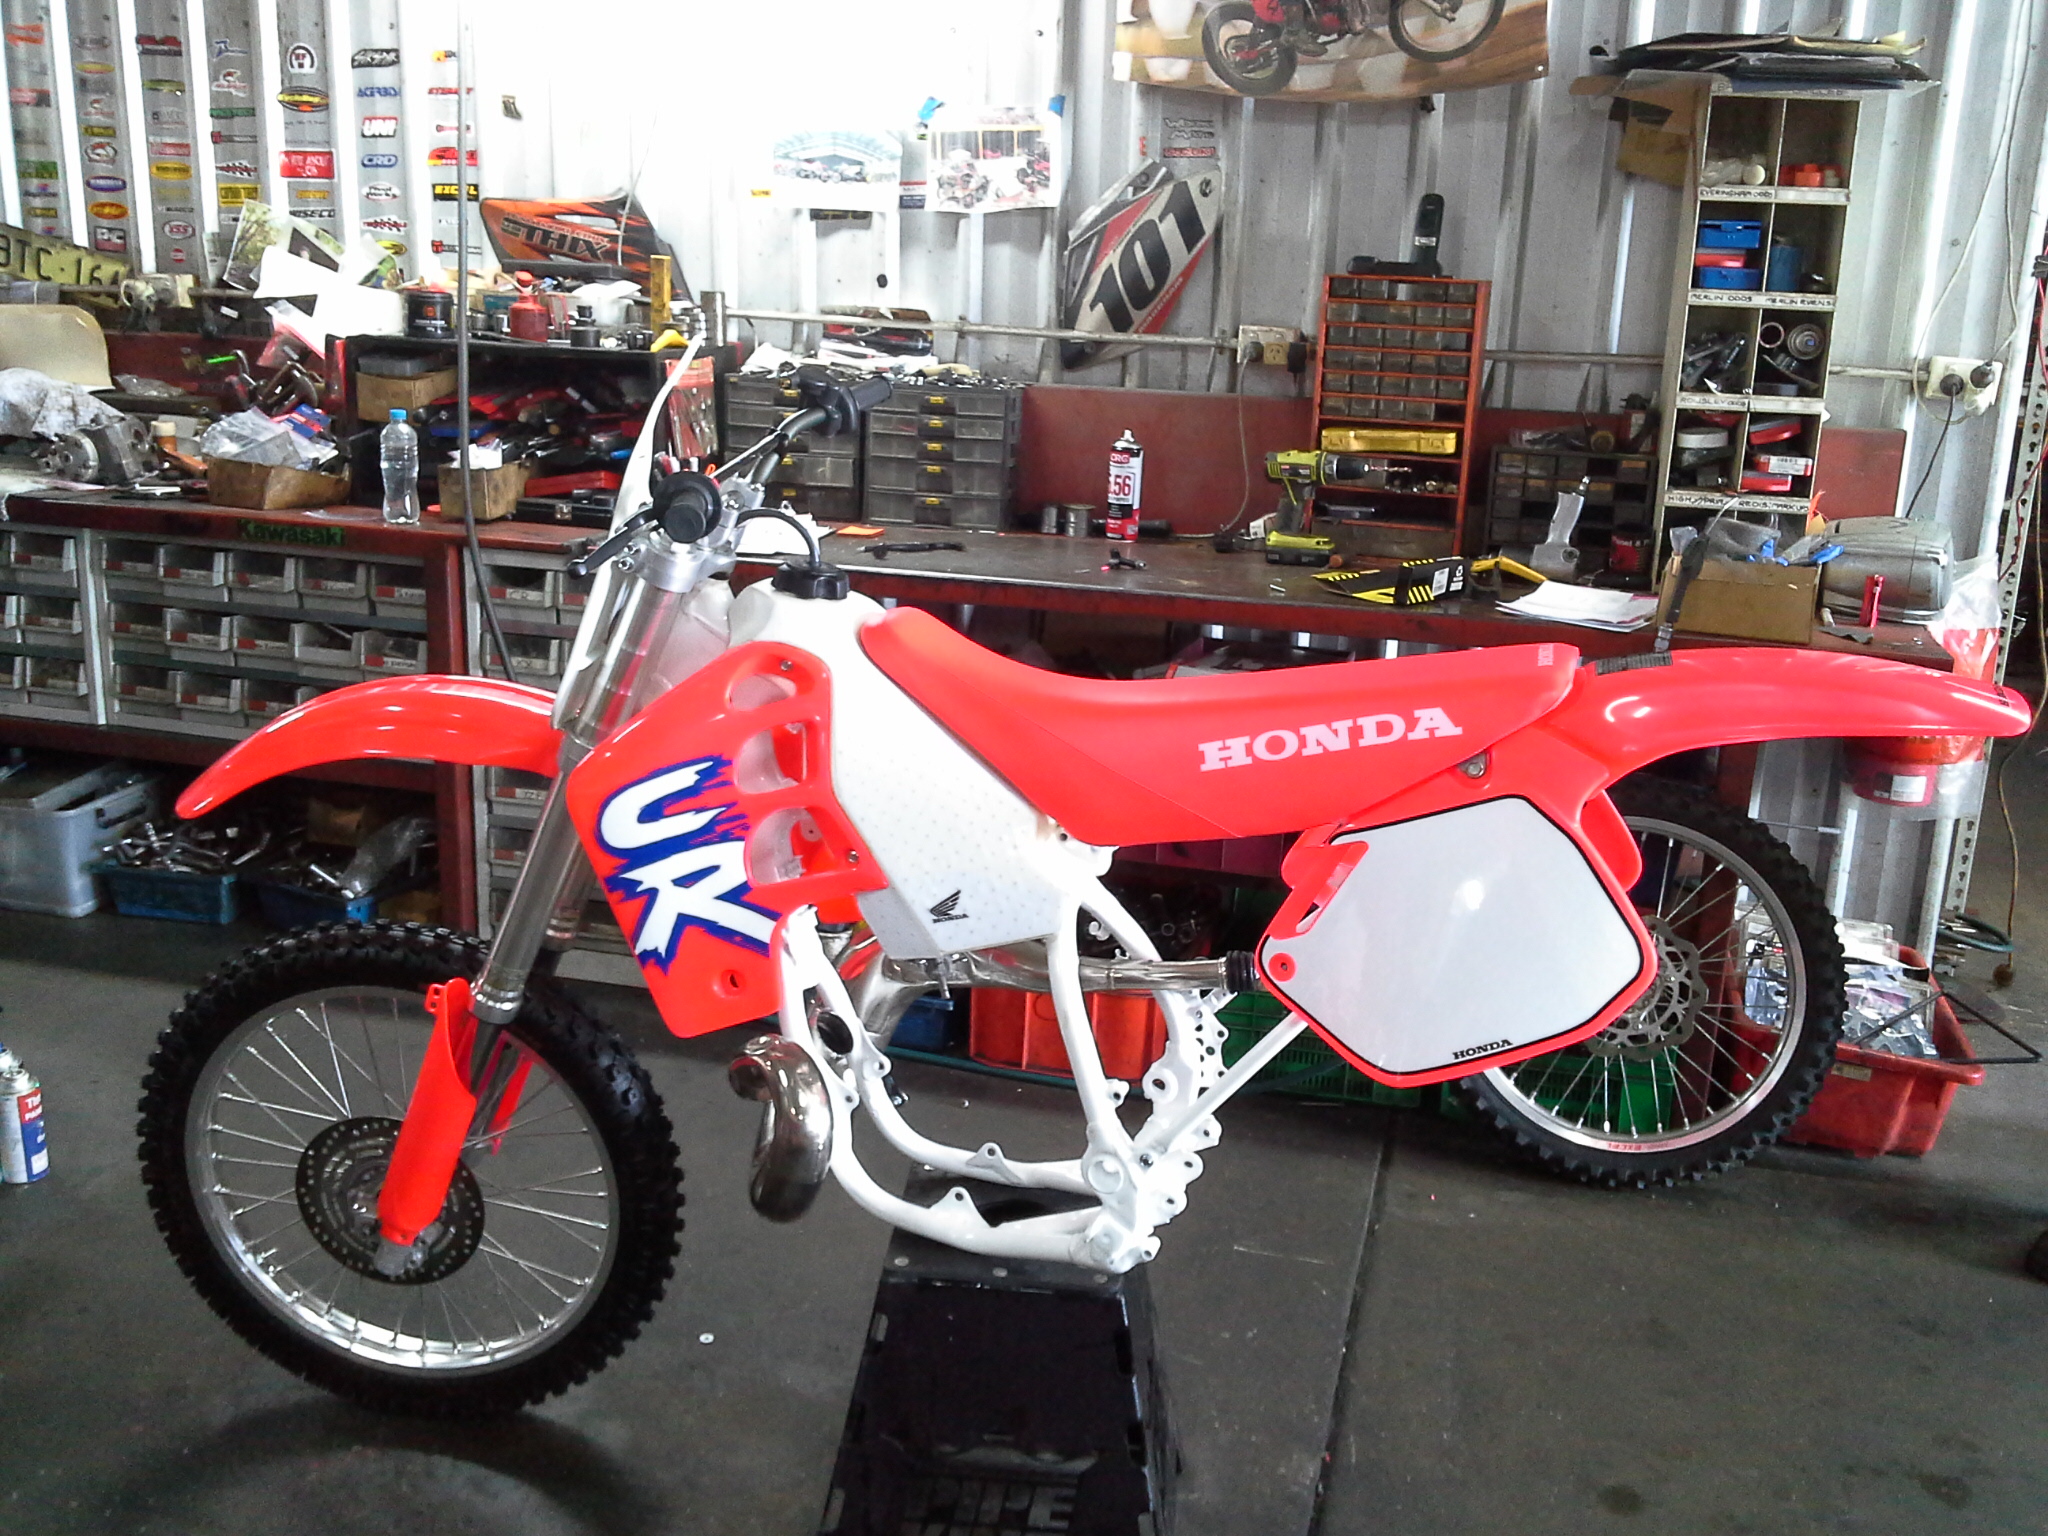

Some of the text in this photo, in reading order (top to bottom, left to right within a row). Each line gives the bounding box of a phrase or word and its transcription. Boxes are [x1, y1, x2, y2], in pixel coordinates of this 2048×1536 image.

[1089, 181, 1206, 333] 101
[1198, 706, 1463, 772] HONDA
[597, 757, 784, 972] CR
[932, 913, 970, 924] HONDA
[1452, 1039, 1513, 1060] HONDA
